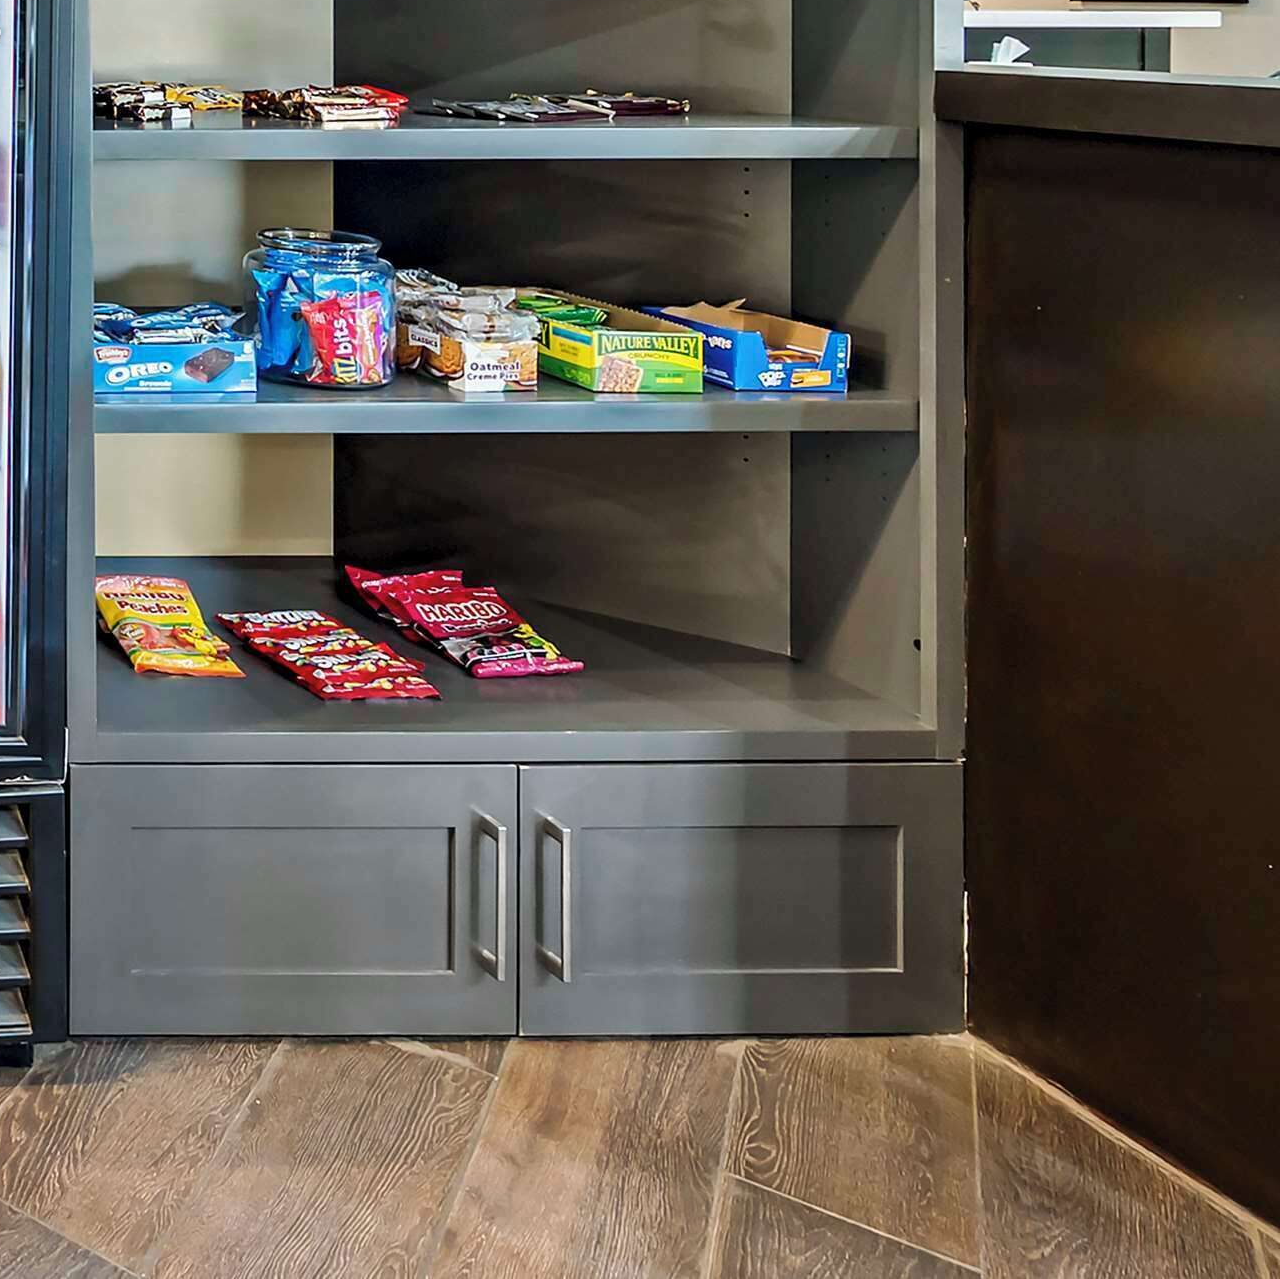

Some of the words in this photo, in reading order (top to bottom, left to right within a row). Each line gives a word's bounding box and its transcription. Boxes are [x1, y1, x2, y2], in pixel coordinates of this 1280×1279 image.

[601, 335, 650, 353] NATURE
[651, 336, 697, 357] VALLEY
[627, 352, 671, 360] CRUNCHY
[470, 361, 520, 371] Oatmeal
[106, 362, 173, 385] OREO
[466, 373, 498, 381] Creme
[499, 372, 518, 380] Pies
[117, 601, 188, 614] Peaches
[416, 601, 507, 622] HARIBO
